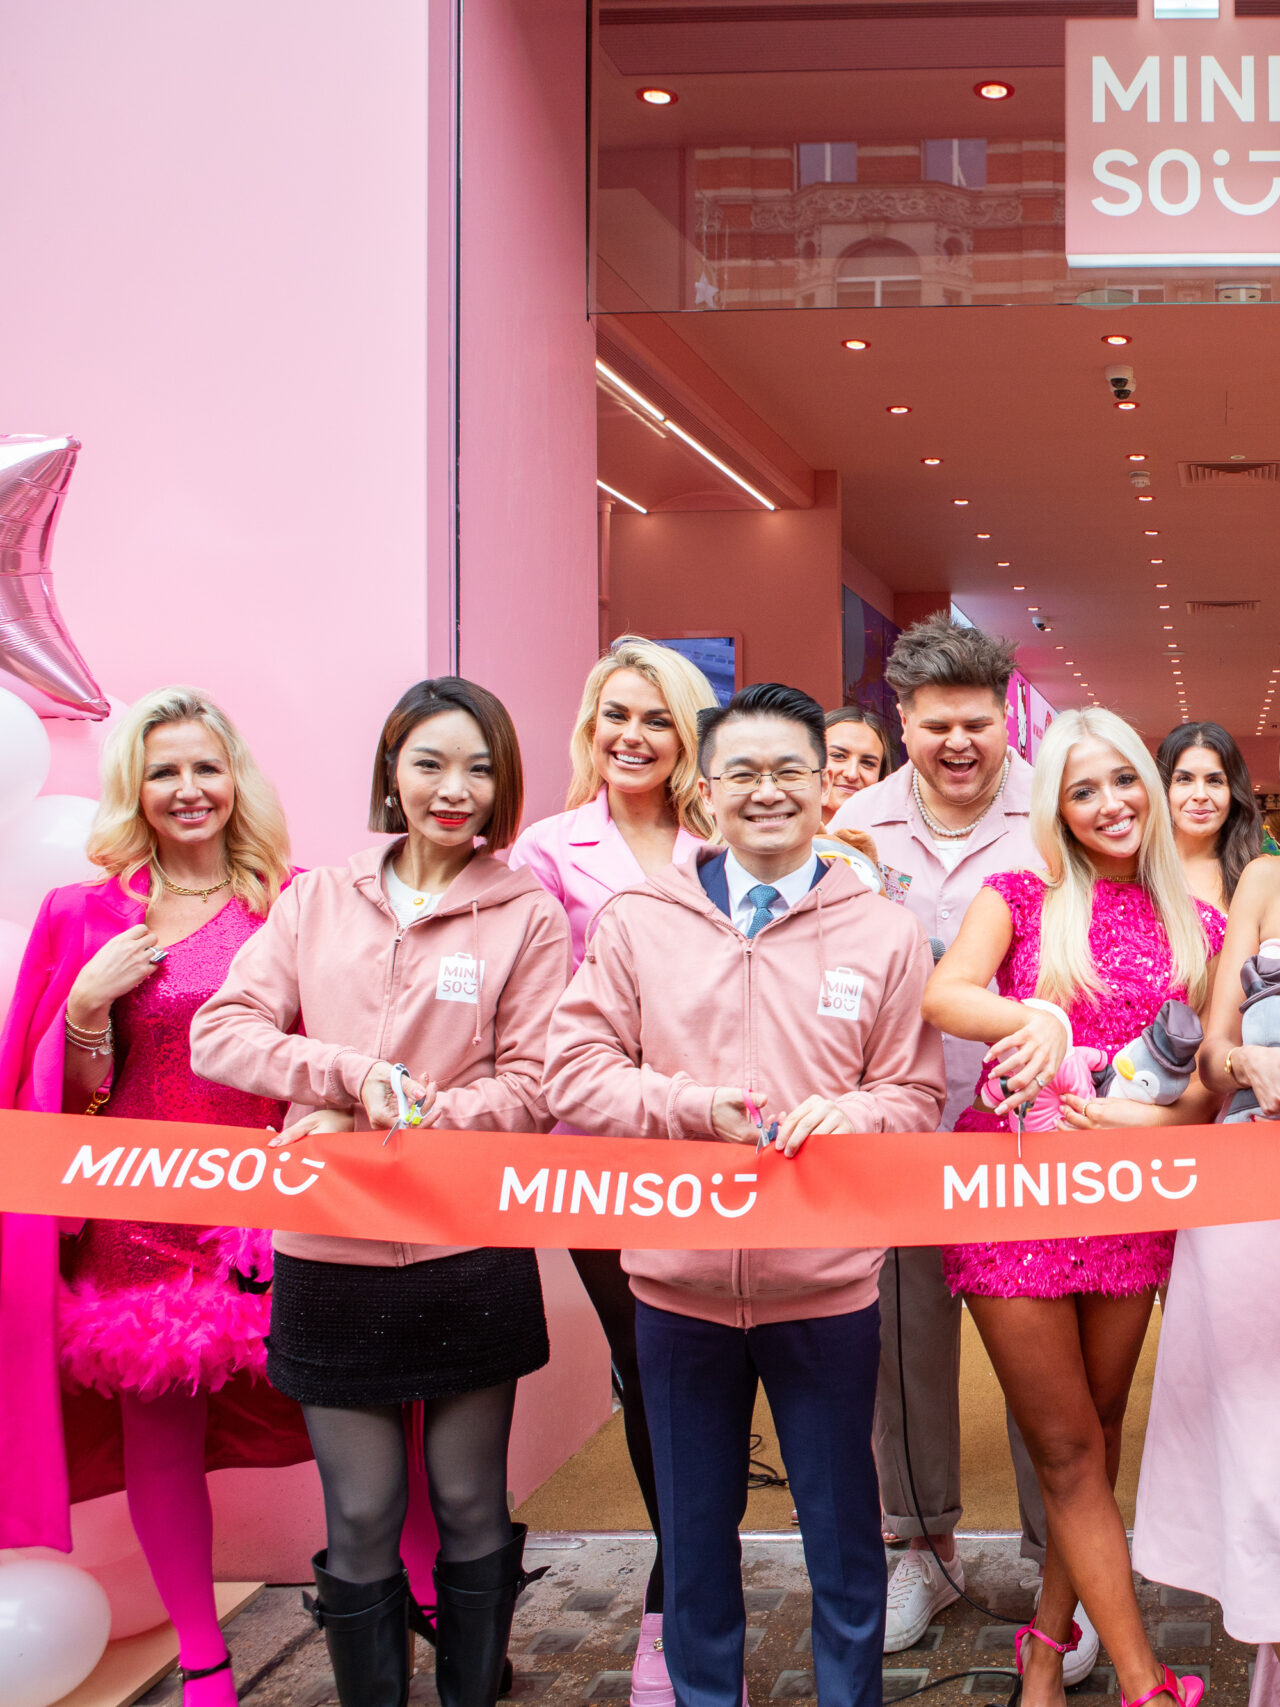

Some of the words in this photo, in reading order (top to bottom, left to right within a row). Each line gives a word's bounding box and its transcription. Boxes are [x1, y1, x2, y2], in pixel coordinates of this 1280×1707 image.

[1091, 148, 1201, 217] SO
[441, 980, 462, 993] SO
[444, 965, 479, 979] MIN
[62, 1144, 267, 1191] MINISO
[943, 1160, 1143, 1210] MINISO
[498, 1166, 702, 1218] MINISO
